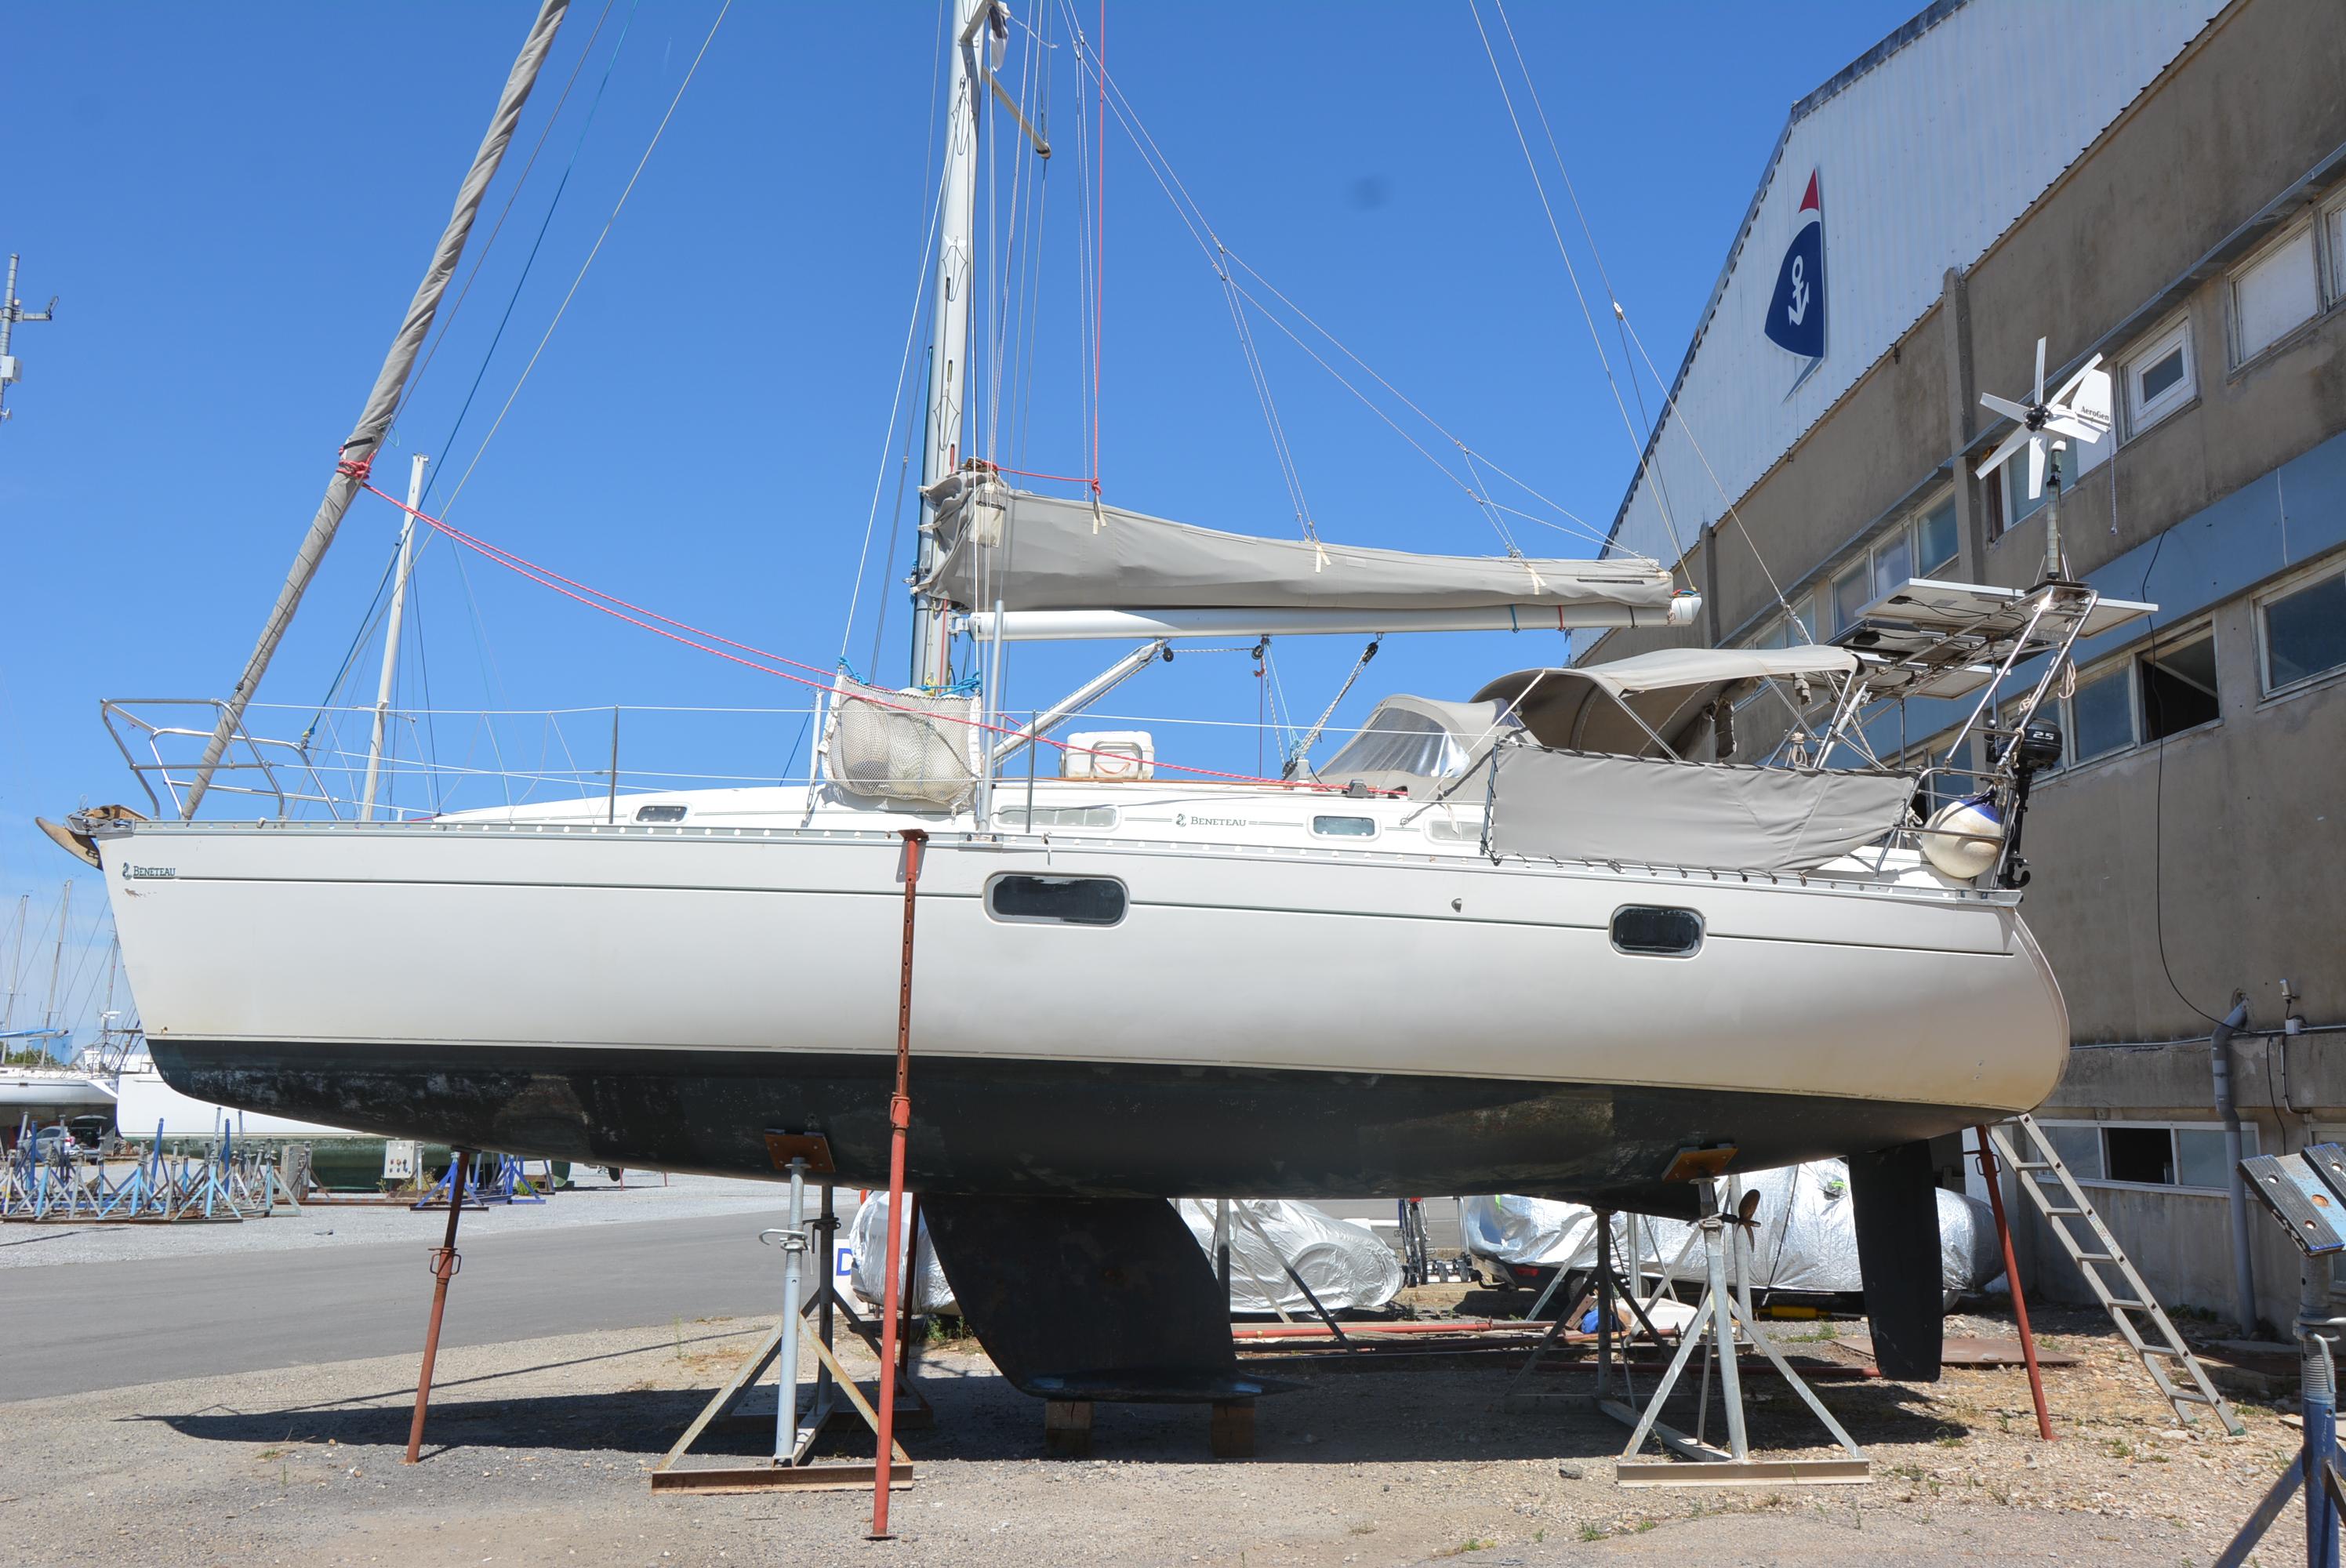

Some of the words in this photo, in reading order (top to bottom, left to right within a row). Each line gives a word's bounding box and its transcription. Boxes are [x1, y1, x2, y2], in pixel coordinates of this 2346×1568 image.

[2081, 405, 2109, 421] AeroGen
[1190, 816, 1247, 826] BENETEAU
[133, 866, 176, 877] BENETEAU
